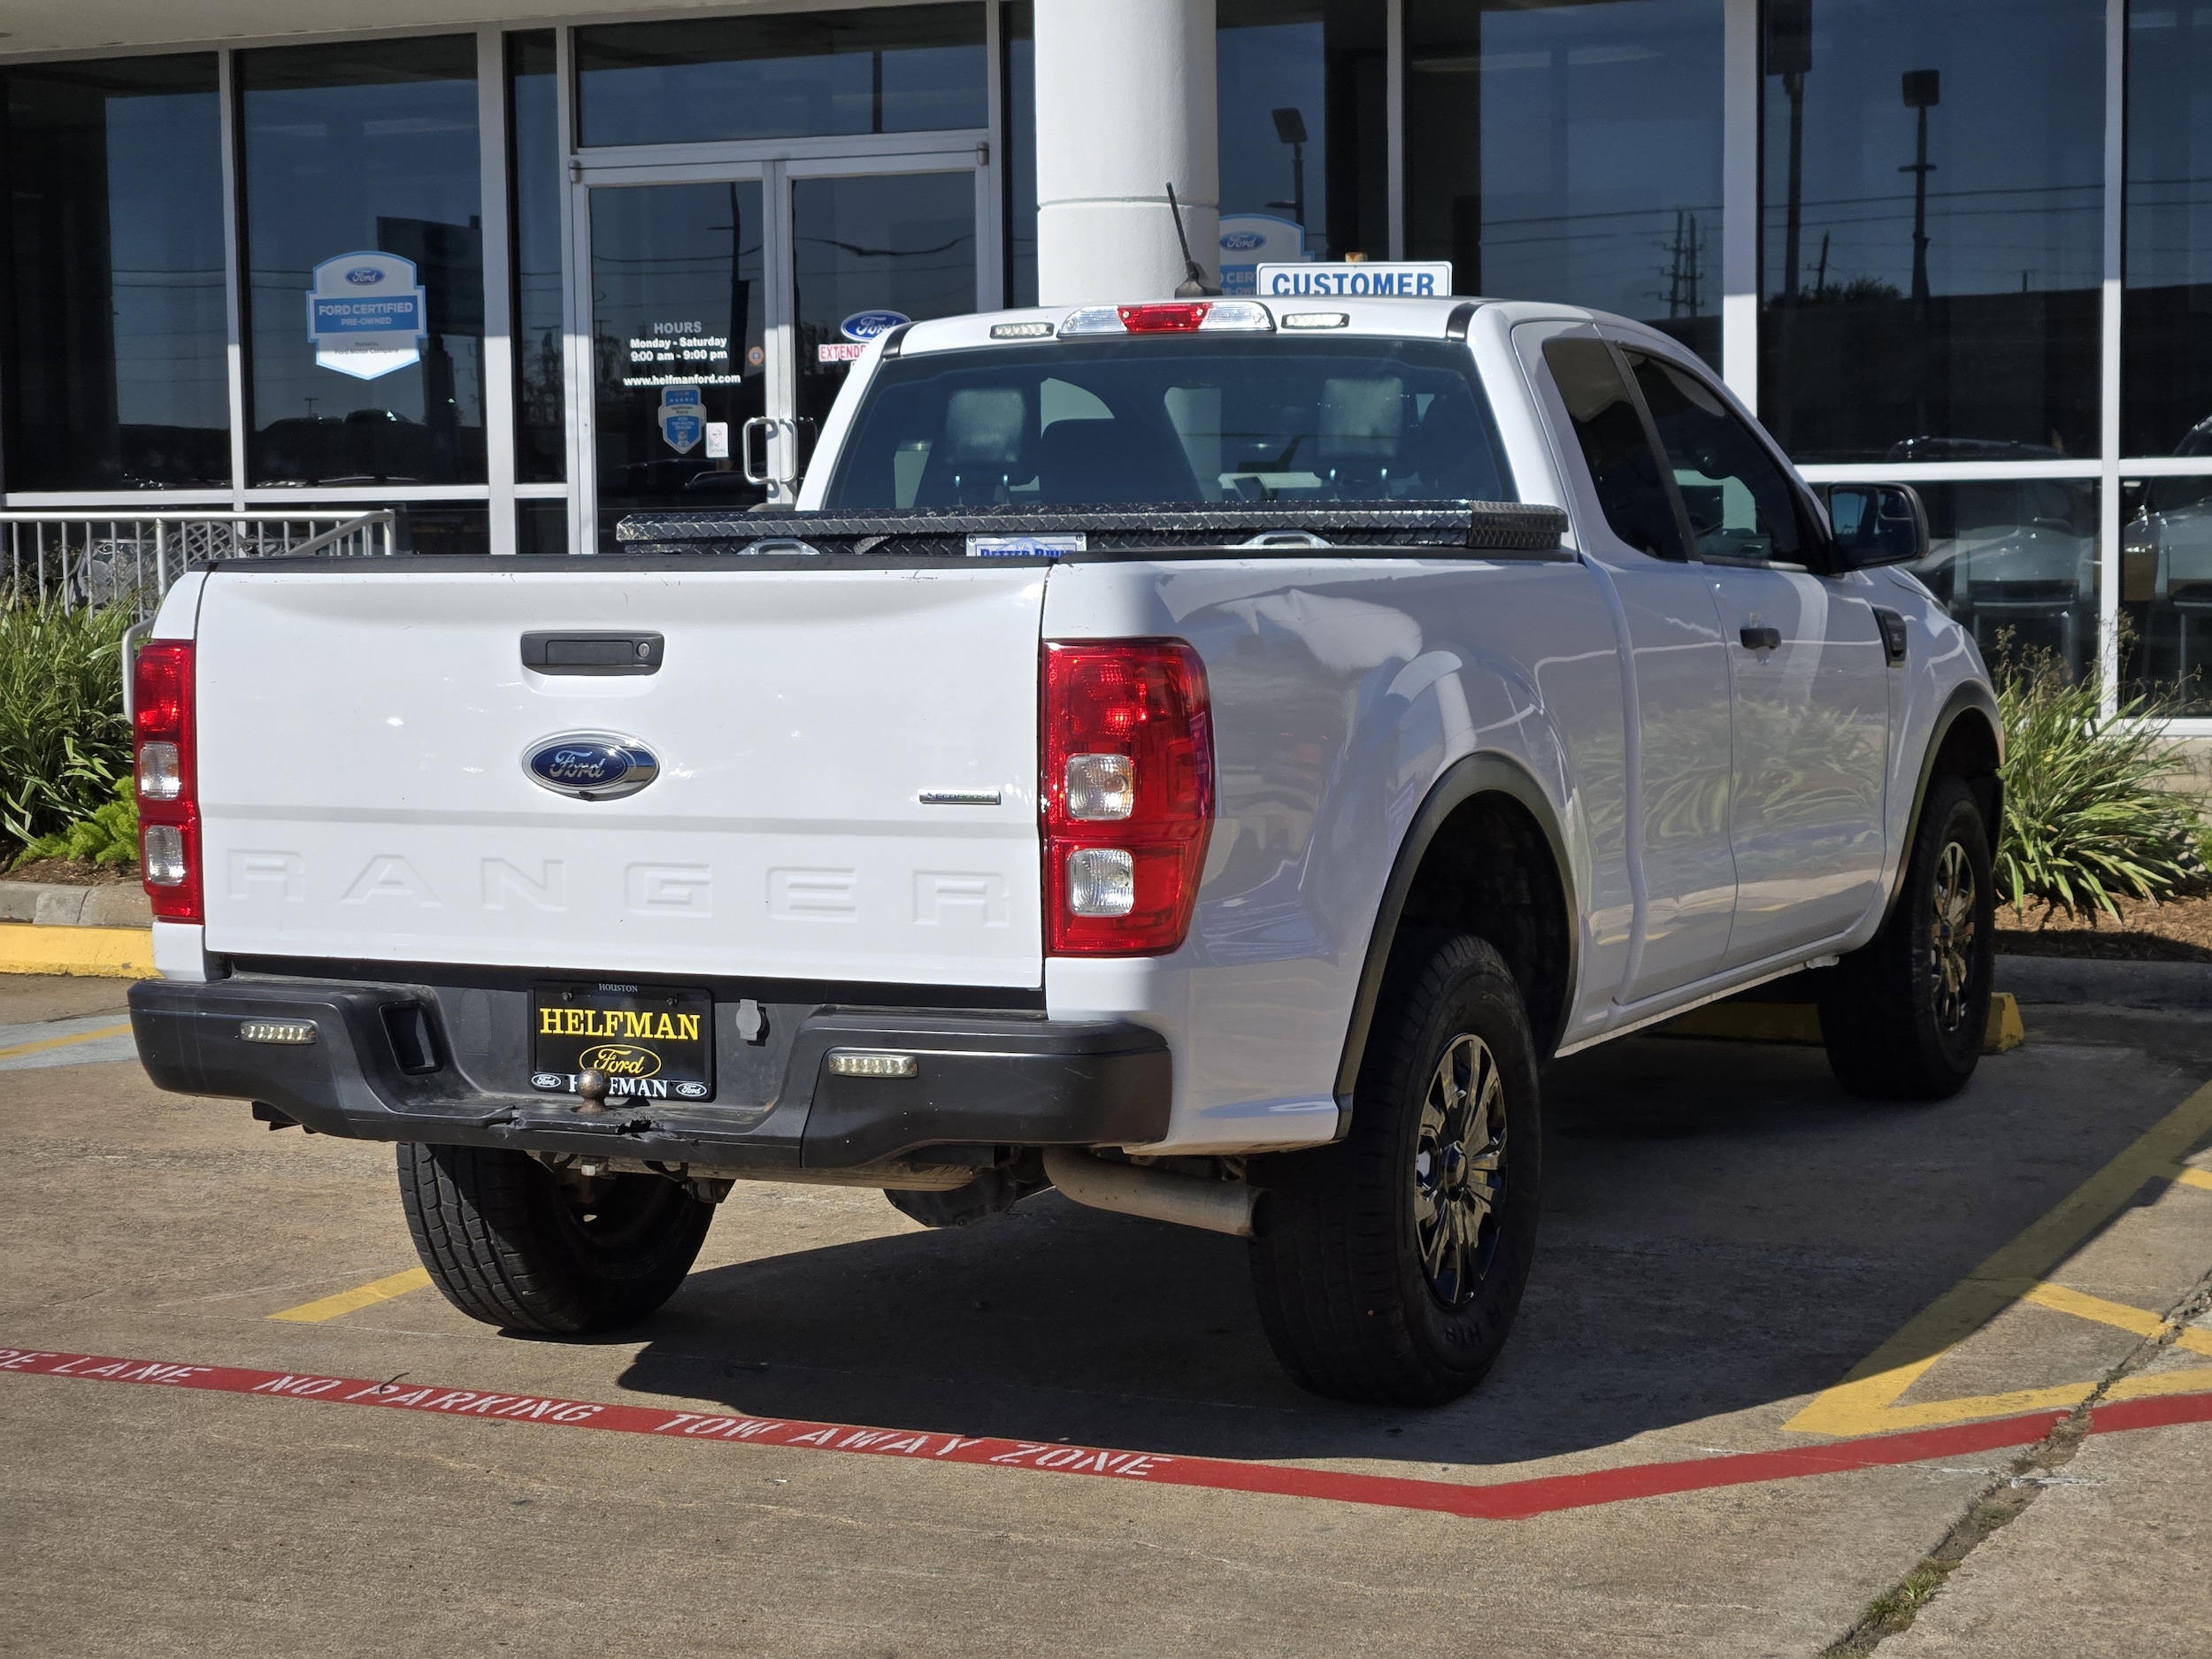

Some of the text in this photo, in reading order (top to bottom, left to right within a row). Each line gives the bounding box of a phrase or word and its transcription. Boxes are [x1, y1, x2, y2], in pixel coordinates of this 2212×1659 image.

[1227, 234, 1256, 248] Ford
[1272, 273, 1435, 296] CUSTOMER
[319, 302, 414, 316] FORD CERTIFIED
[341, 317, 392, 326] PRE-OWNED
[654, 321, 703, 334] HOURS
[630, 338, 671, 349] Monday
[679, 336, 727, 348] Saturday
[631, 351, 654, 362] 9:00
[683, 349, 707, 360] 9:00
[710, 350, 727, 361] pm
[623, 374, 741, 386] www.helfmanford.com
[549, 749, 607, 779] Ford
[227, 849, 1010, 928] RANGER
[598, 983, 639, 993] HOUSTON
[540, 1008, 701, 1041] HELFMAN
[594, 1048, 645, 1074] Ford
[569, 1075, 669, 1098] HFMAN
[50, 1356, 213, 1384] LANE
[251, 1375, 342, 1395] NO
[343, 1384, 605, 1423] PARKING
[654, 1413, 786, 1439] TOW
[786, 1427, 984, 1456] AWAY
[989, 1444, 1172, 1476] ZONE
